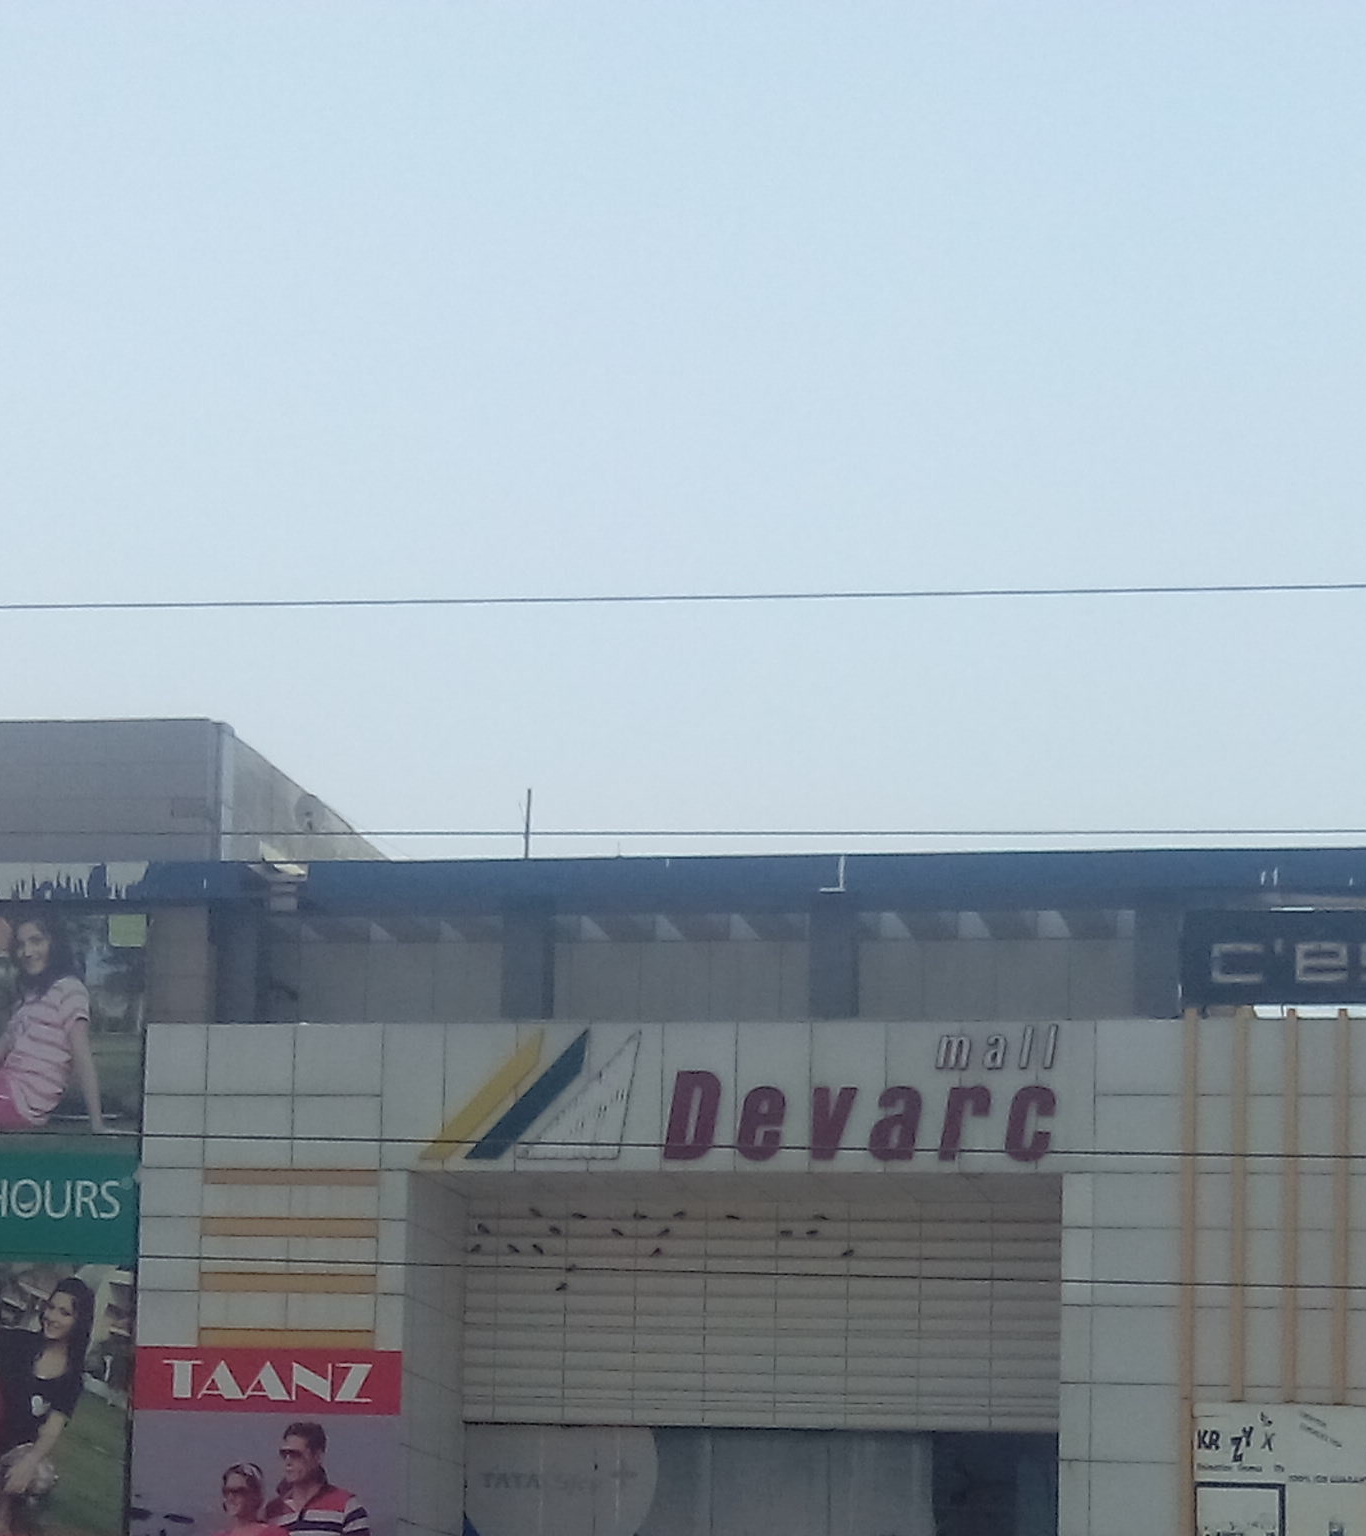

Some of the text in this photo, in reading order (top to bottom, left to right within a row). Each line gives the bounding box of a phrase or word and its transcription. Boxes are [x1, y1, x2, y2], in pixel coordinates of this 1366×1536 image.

[935, 1023, 1060, 1070] mall
[663, 1069, 1058, 1162] Devarc
[162, 1359, 374, 1403] TAANZ
